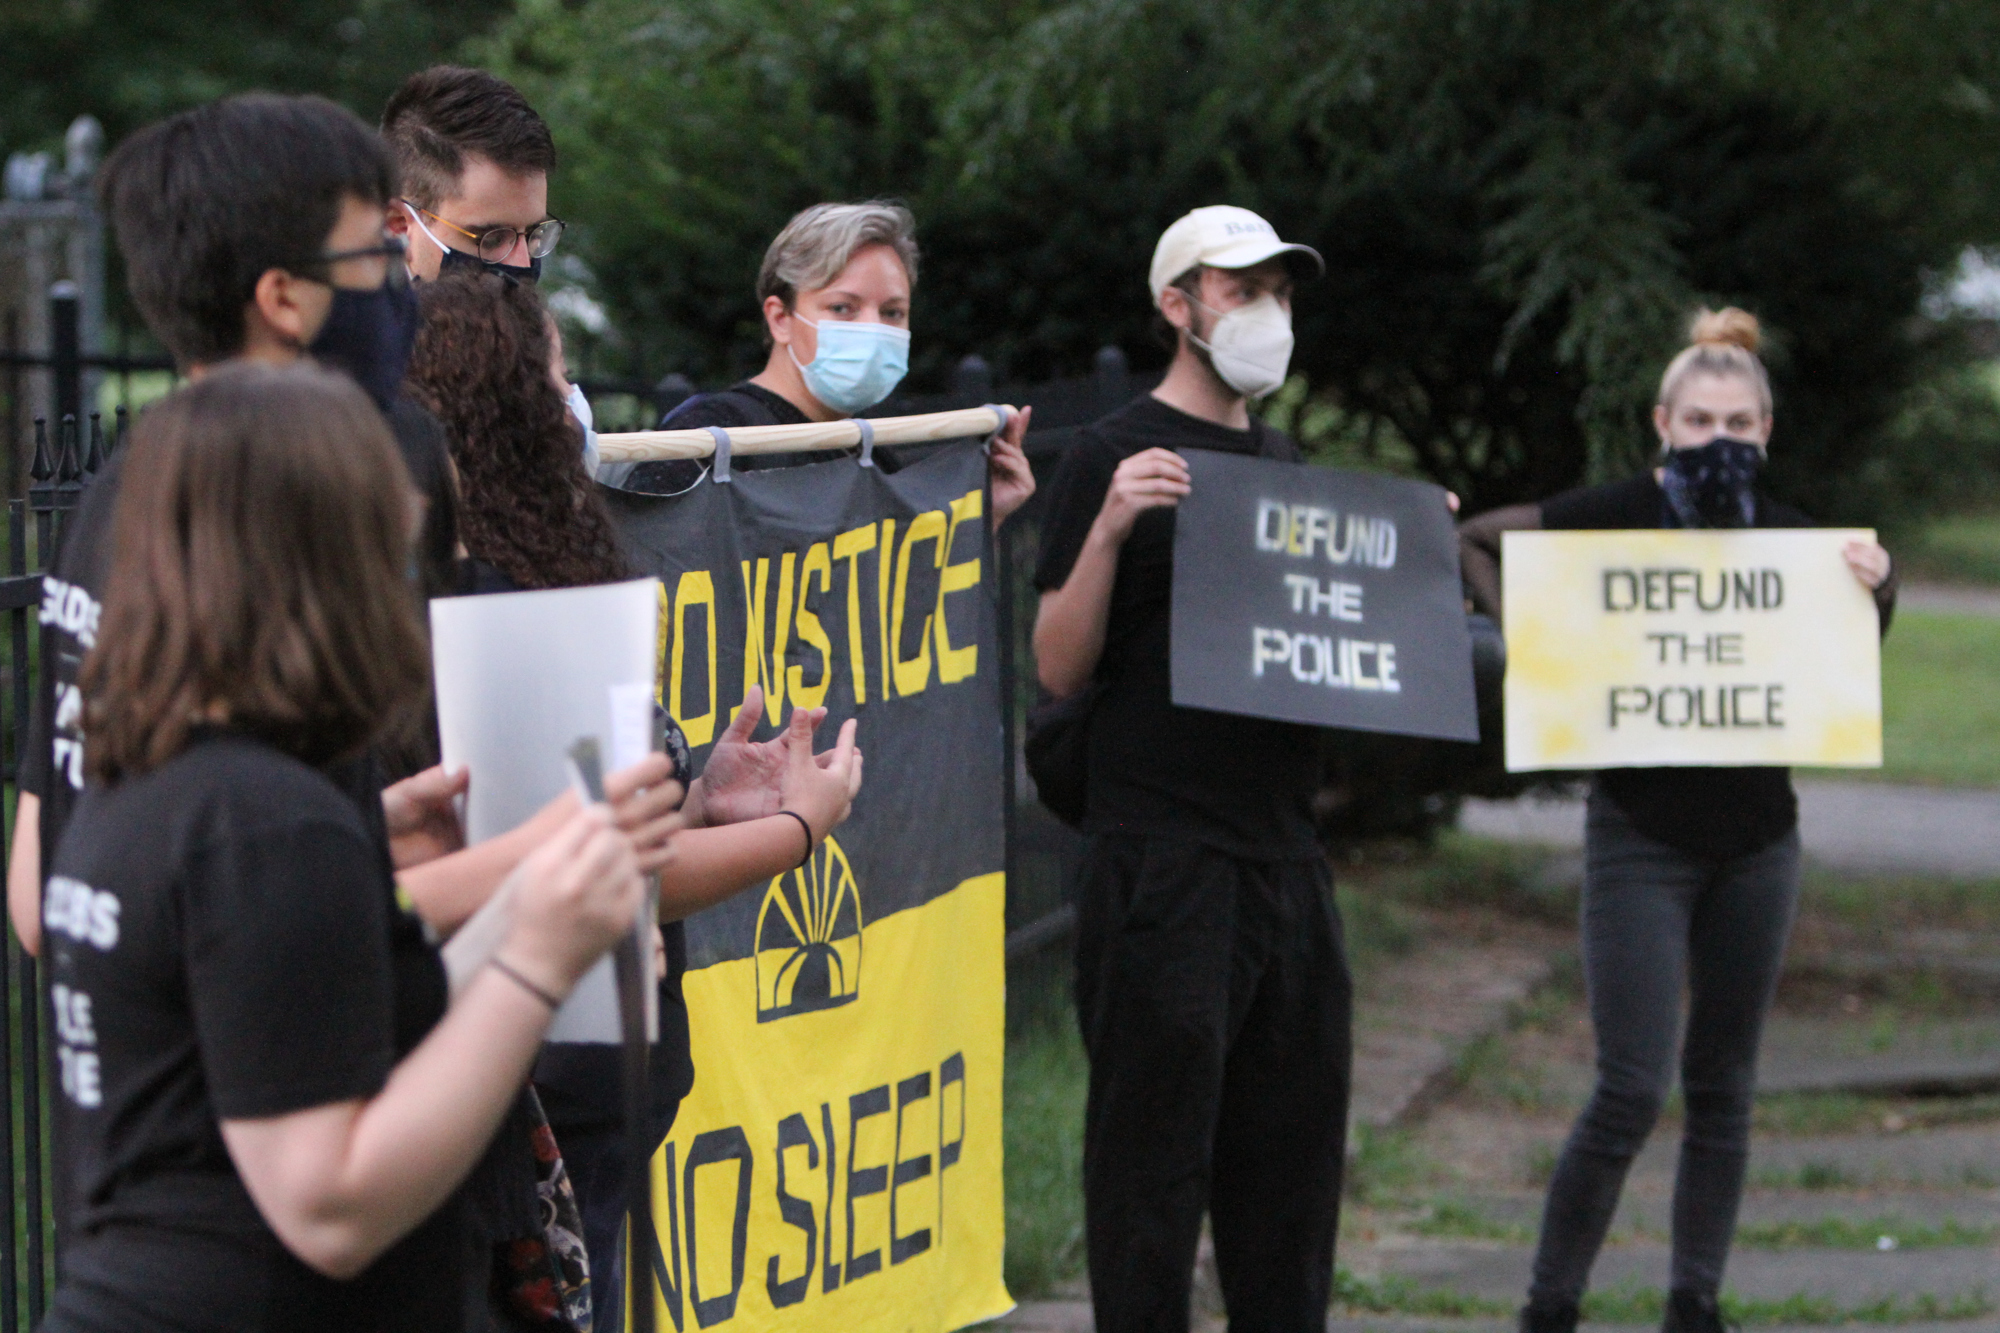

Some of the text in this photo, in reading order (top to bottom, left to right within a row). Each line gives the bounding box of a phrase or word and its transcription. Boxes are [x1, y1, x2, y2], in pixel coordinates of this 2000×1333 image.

[1255, 500, 1398, 569] DEFUND
[655, 489, 983, 748] O JUSTICE
[1284, 573, 1364, 622] THE
[1603, 567, 1785, 613] DEFUND
[1253, 626, 1401, 693] POLICE
[1645, 631, 1746, 666] THE
[1607, 684, 1785, 730] POLICE
[766, 1050, 966, 1310] SLEEP
